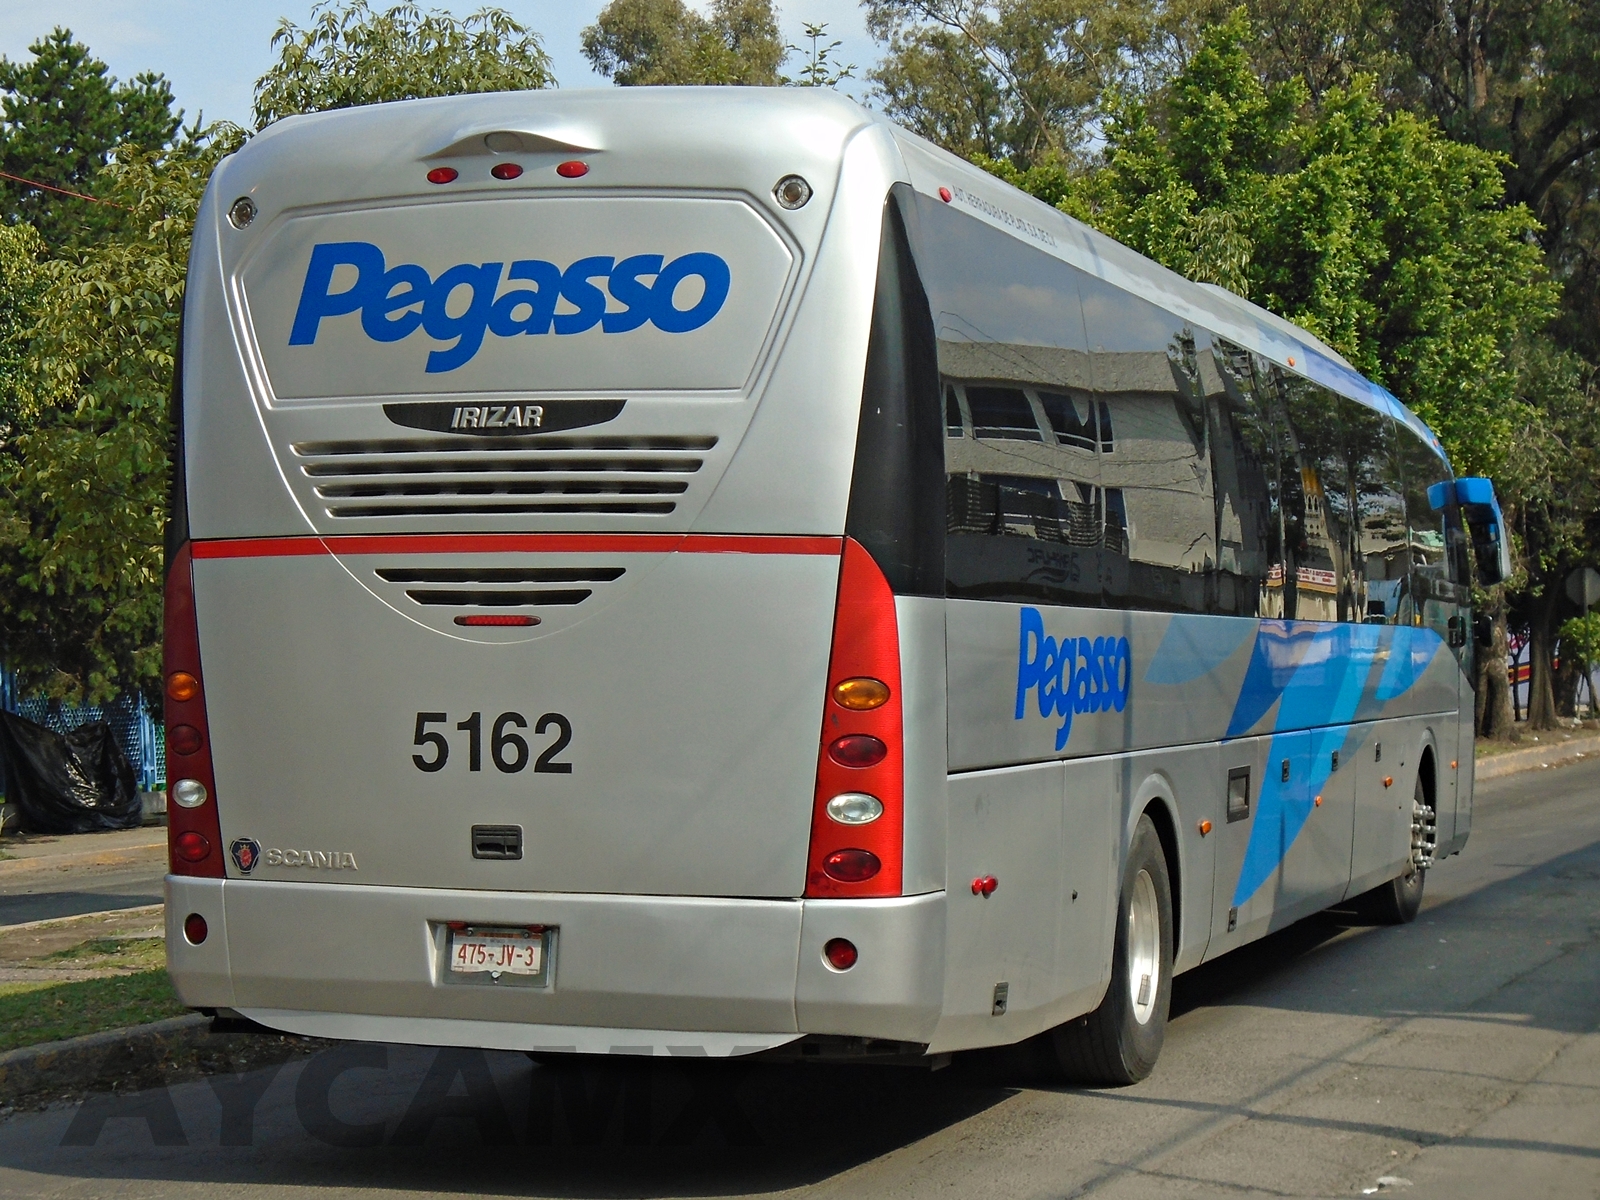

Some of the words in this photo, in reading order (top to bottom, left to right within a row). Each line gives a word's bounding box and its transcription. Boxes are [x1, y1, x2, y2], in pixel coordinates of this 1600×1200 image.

[288, 240, 731, 373] Pegasso
[451, 405, 543, 428] IRIZAR
[1015, 607, 1132, 751] Pegasso
[412, 711, 572, 774] 5162
[265, 847, 358, 870] SCANIA
[458, 943, 534, 967] 475-JV-3
